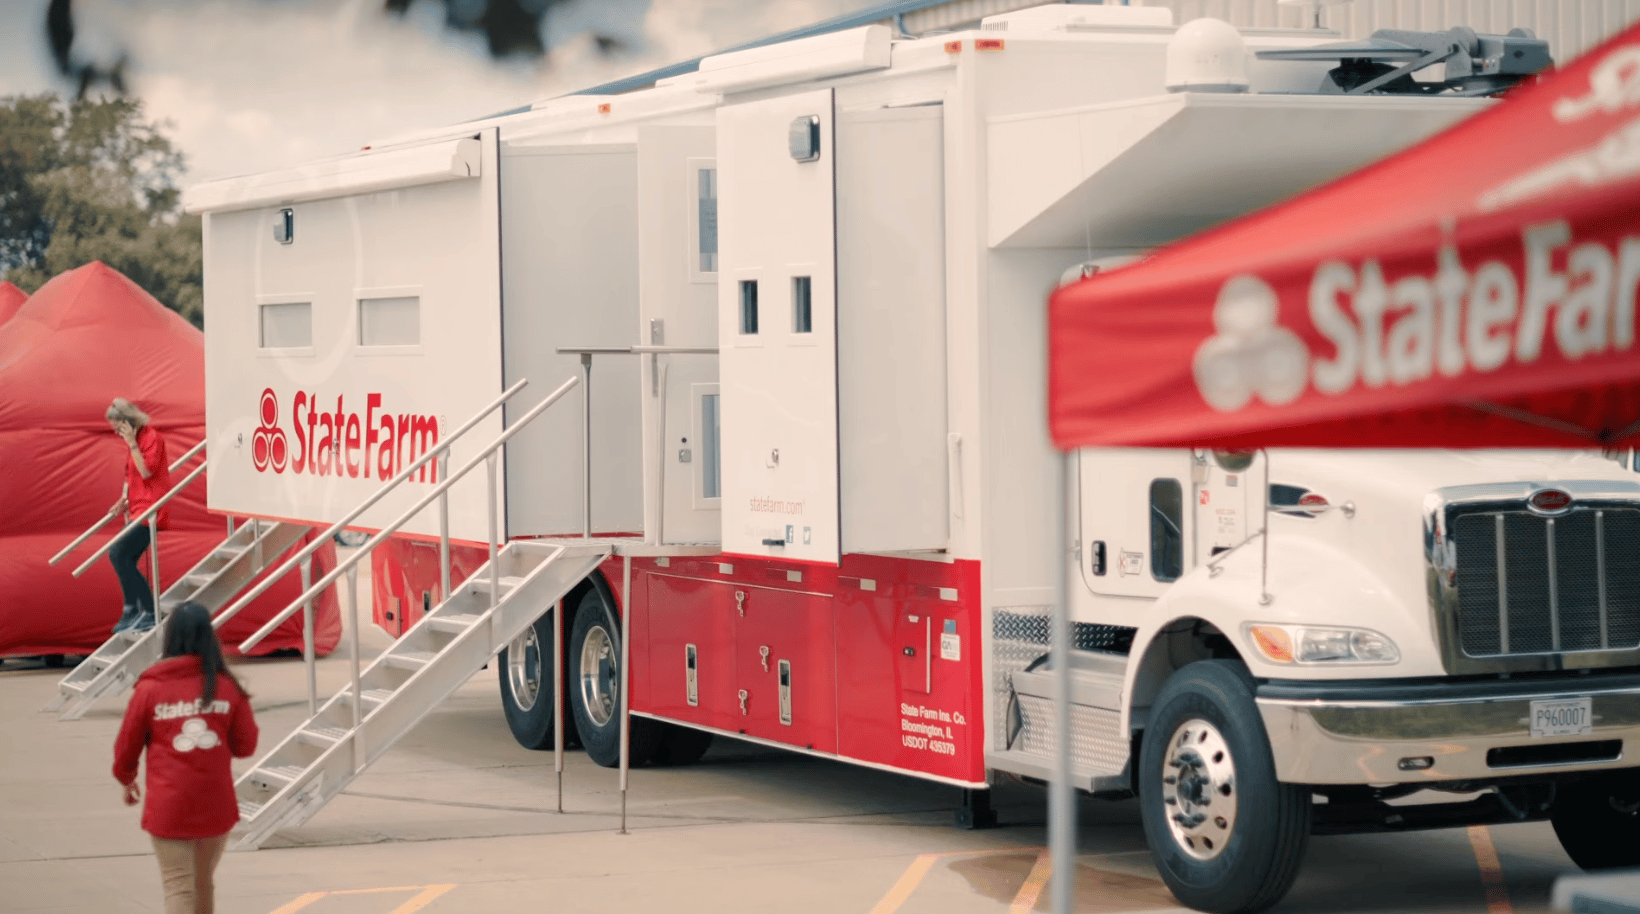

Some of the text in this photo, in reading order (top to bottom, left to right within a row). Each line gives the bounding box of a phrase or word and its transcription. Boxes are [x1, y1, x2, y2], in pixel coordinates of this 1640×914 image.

[292, 390, 438, 484] StateFarm
[749, 495, 803, 515] statefarm.com
[901, 703, 967, 725] State Farm Ins. Co.
[1536, 707, 1586, 727] P960007
[902, 718, 954, 739] Bloomington, IL
[902, 734, 955, 756] USDOT 435379
